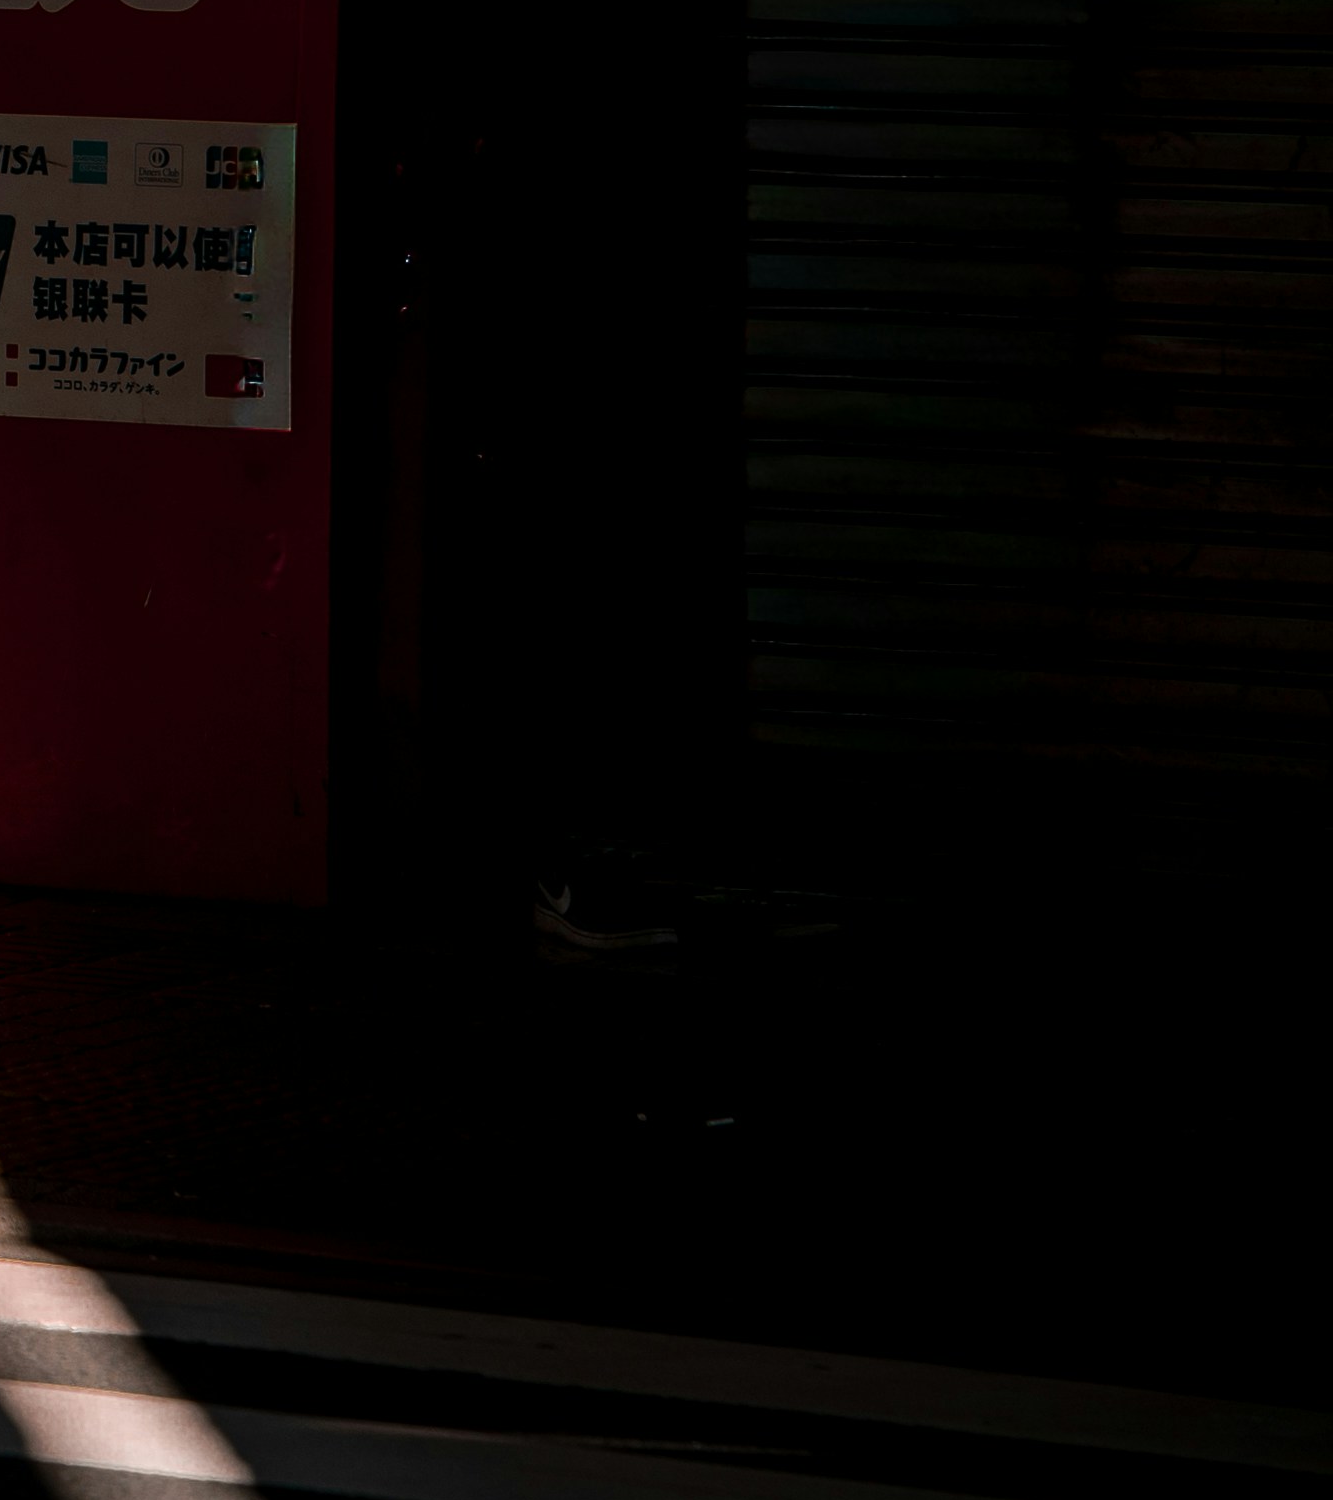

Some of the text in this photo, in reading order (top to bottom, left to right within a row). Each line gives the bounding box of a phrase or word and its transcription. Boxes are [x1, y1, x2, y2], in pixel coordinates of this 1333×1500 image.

[138, 166, 181, 178] Diners Club
[33, 276, 149, 325] 银联卡
[28, 346, 185, 377] ココカラファイン
